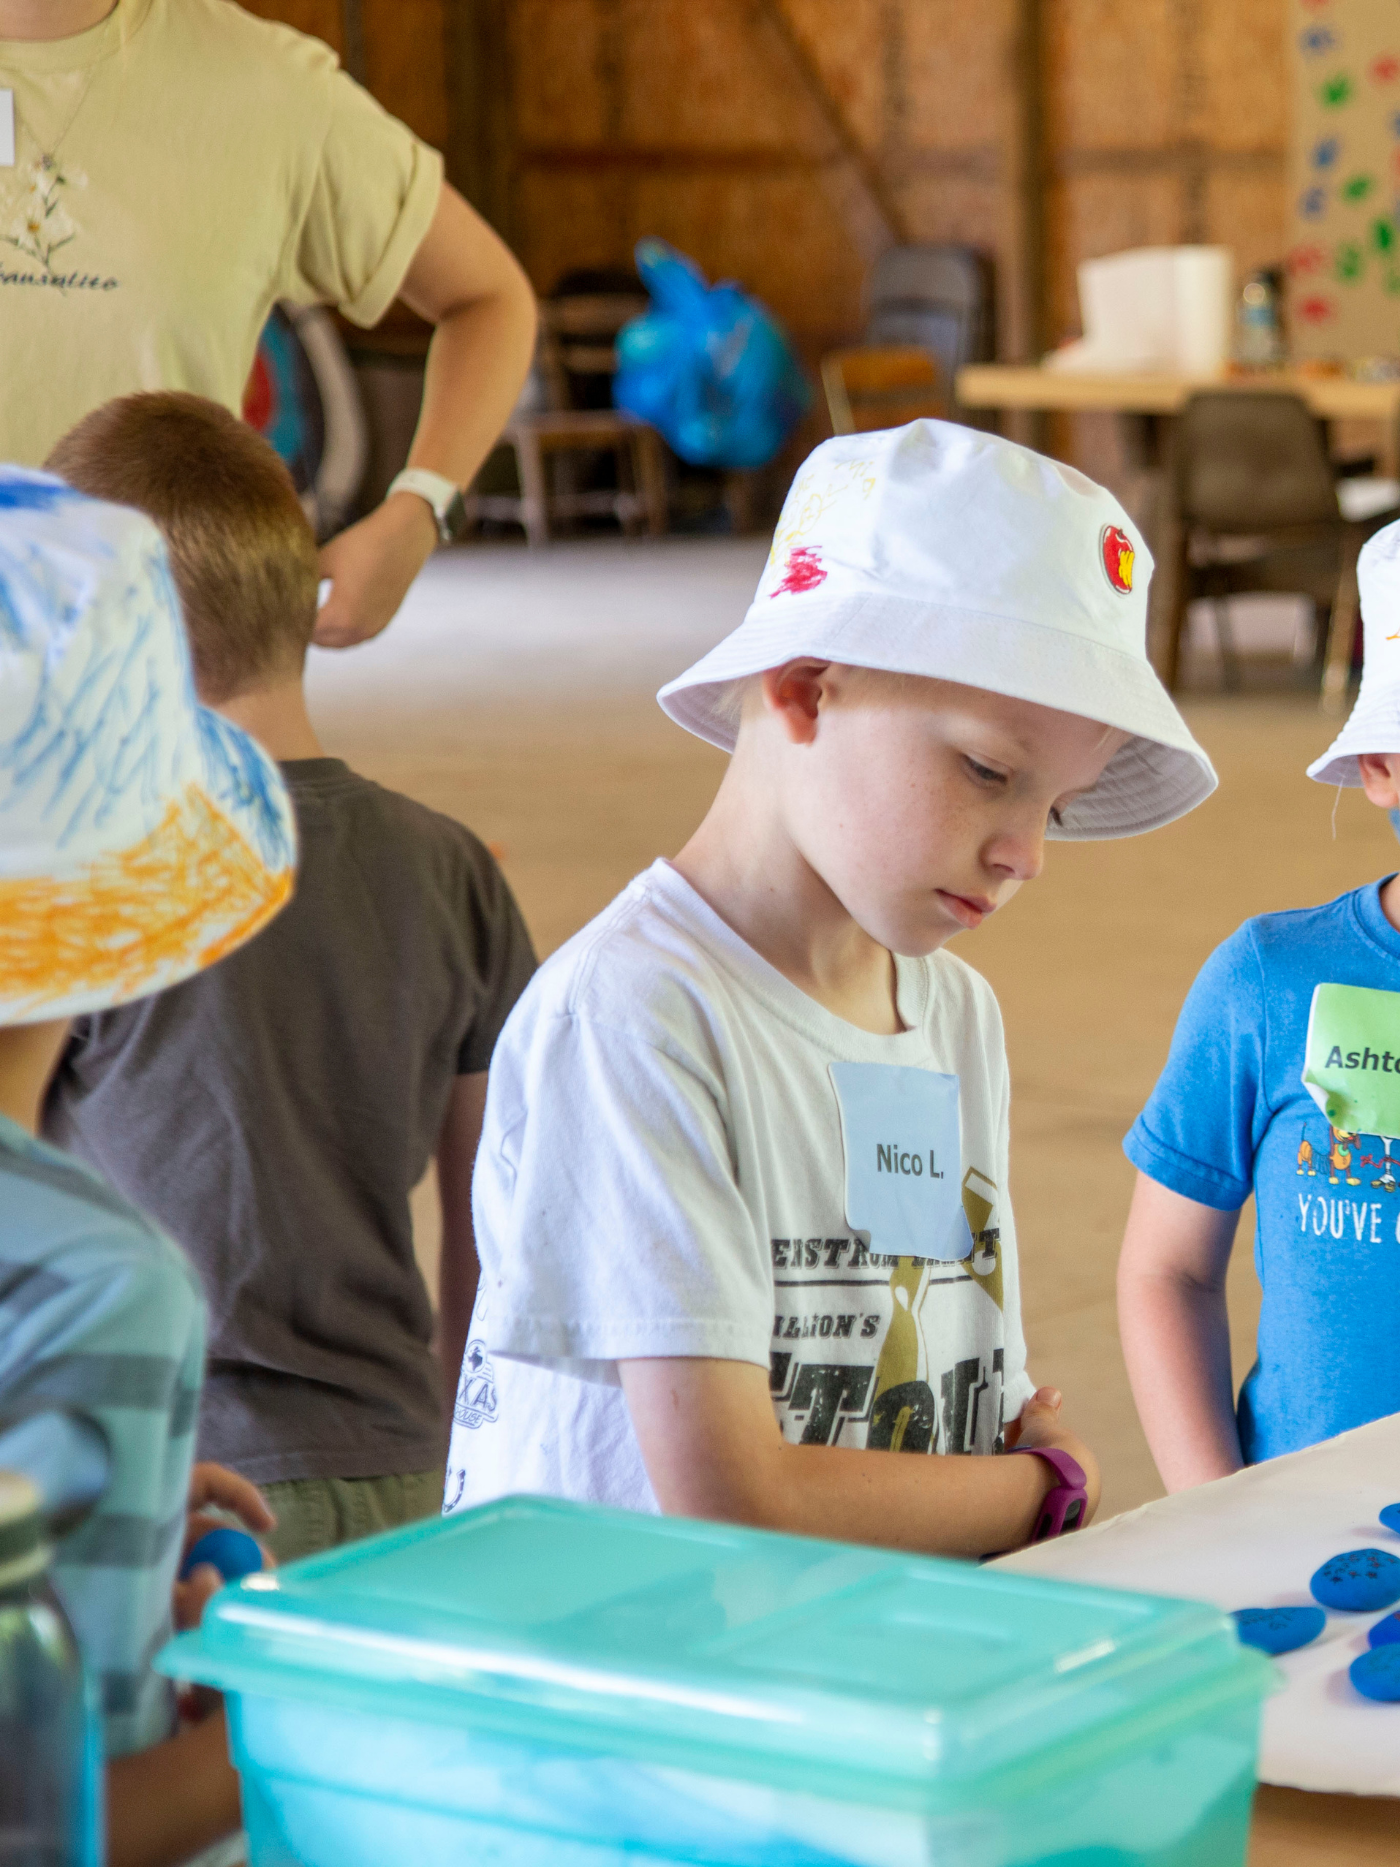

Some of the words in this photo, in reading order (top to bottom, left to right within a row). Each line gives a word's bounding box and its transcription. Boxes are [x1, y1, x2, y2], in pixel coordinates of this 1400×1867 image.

[0, 267, 119, 291] ausalito
[876, 1143, 923, 1178] Nico
[929, 1149, 944, 1180] L.
[1298, 1193, 1382, 1244] YOU'VE
[459, 1374, 498, 1413] XAS
